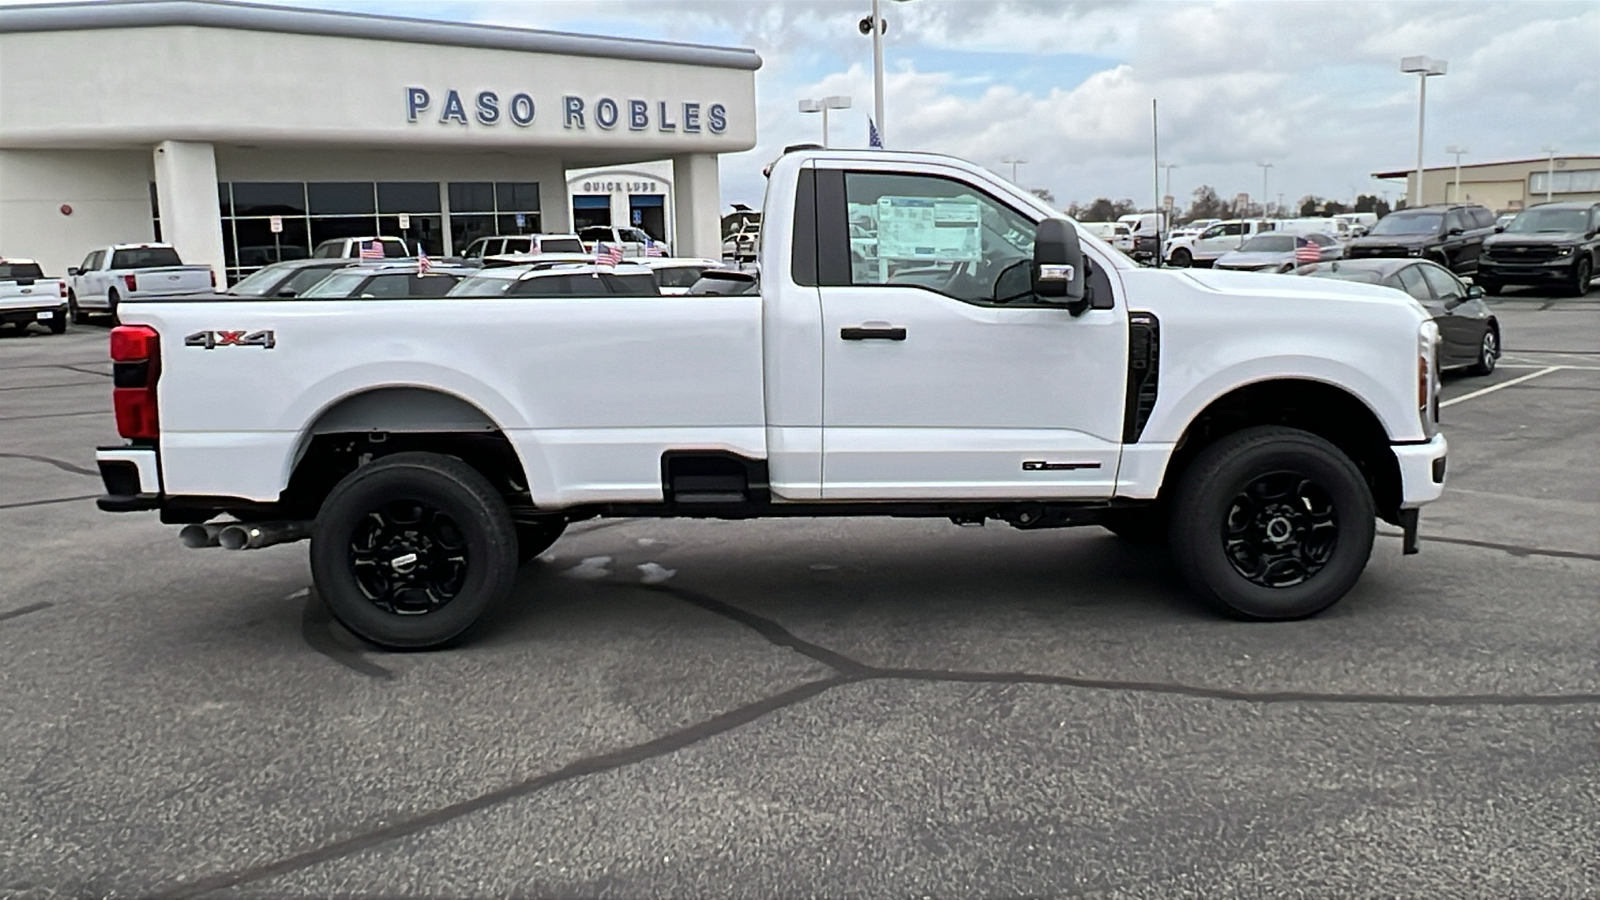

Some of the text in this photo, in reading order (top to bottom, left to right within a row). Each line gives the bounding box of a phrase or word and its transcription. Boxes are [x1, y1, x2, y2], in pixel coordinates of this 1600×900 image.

[406, 86, 728, 135] PASO ROBLES
[583, 182, 623, 192] QUICK
